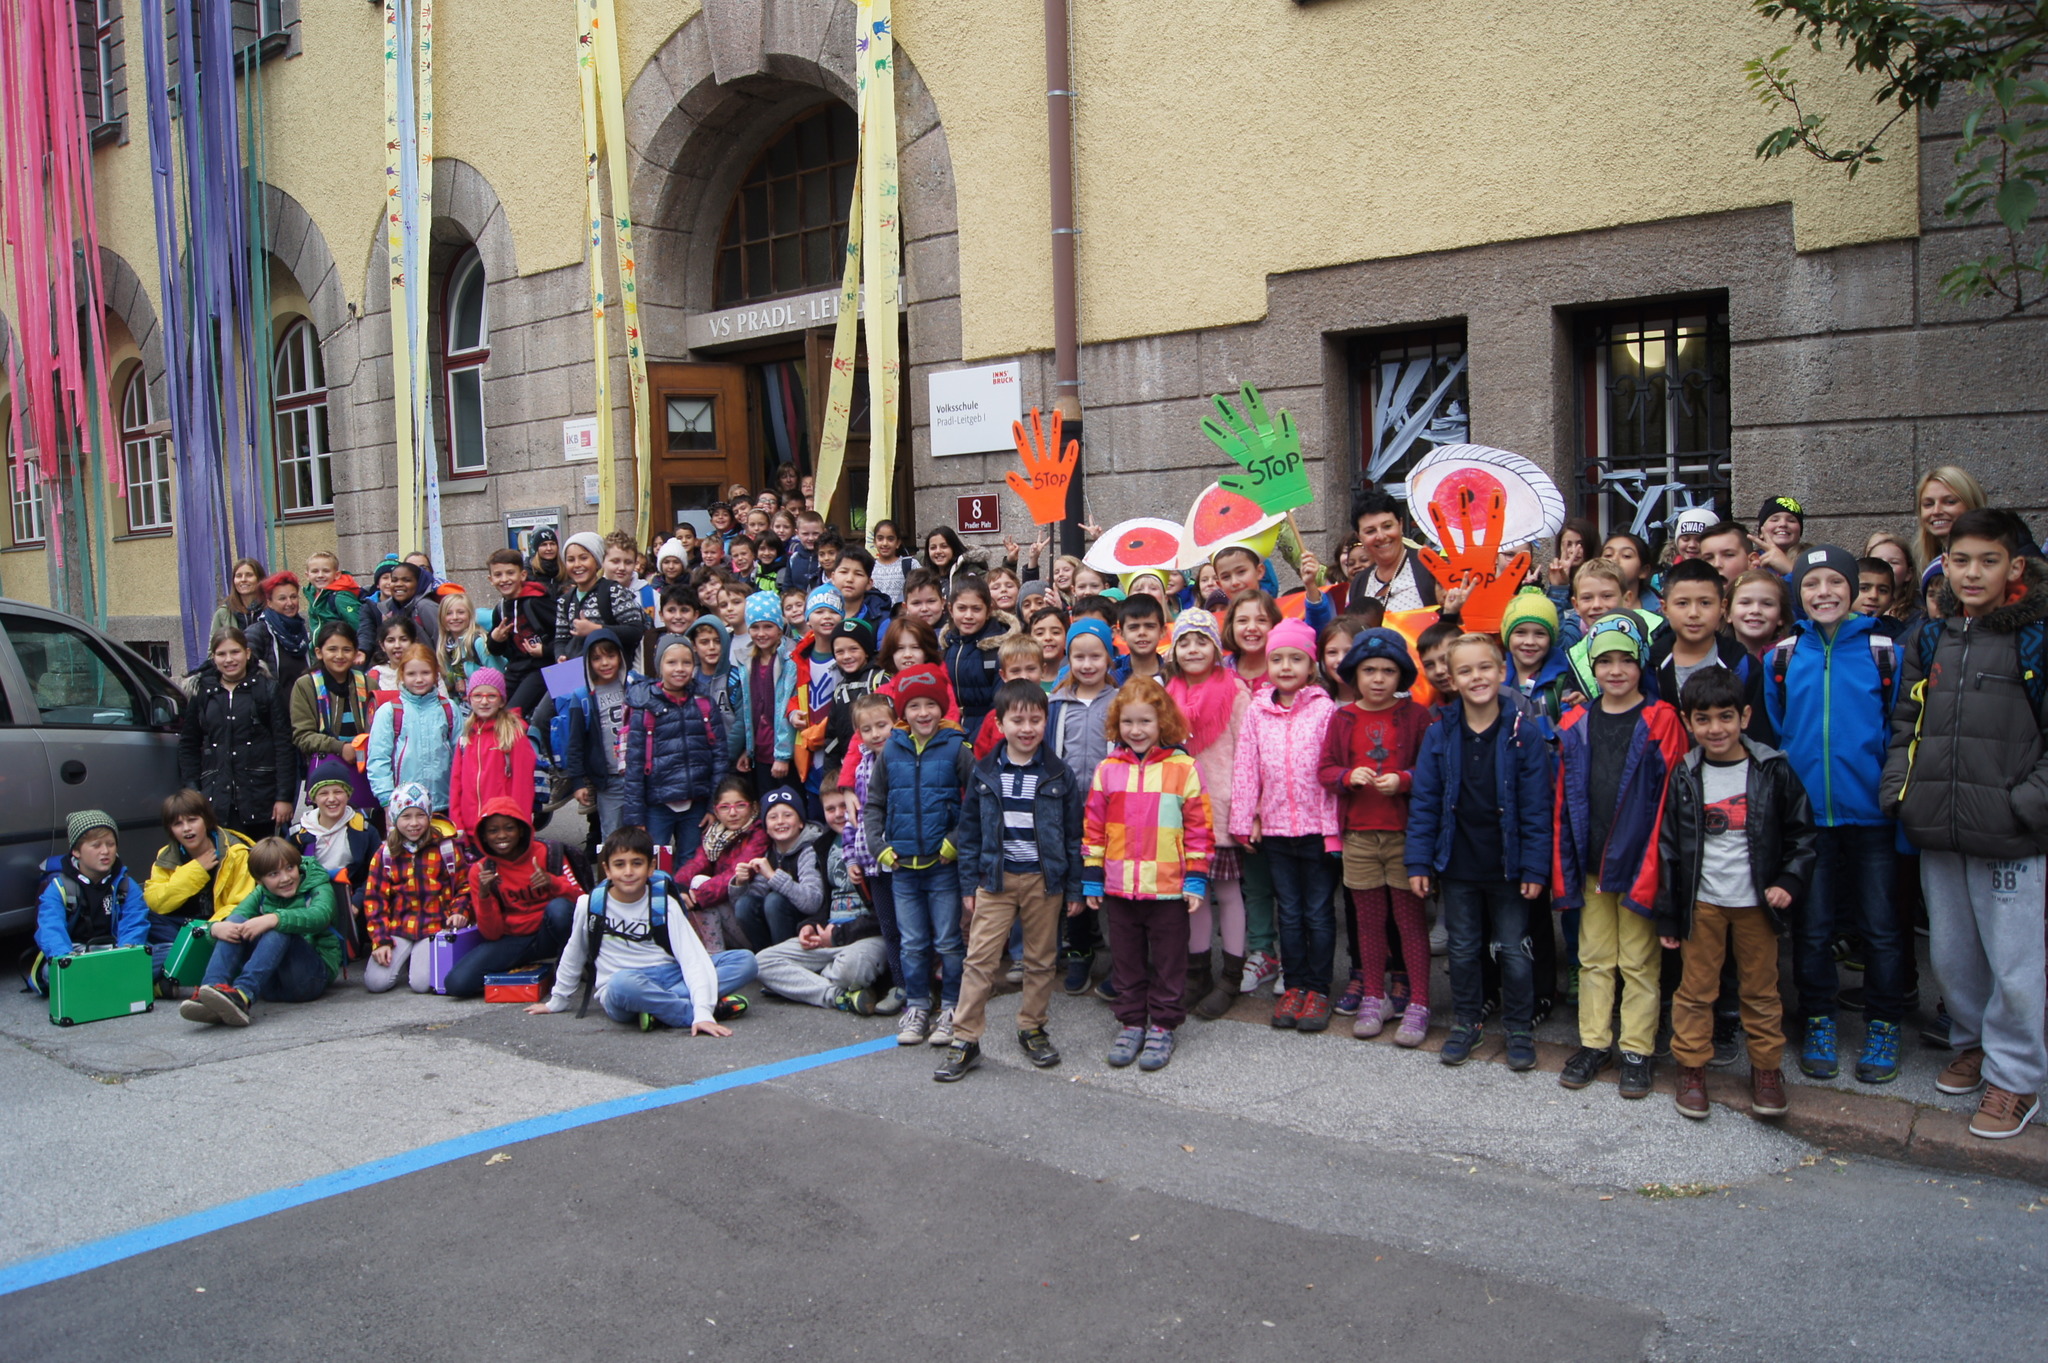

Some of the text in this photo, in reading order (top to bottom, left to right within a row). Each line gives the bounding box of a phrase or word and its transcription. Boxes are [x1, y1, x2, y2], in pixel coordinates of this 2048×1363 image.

[709, 316, 731, 338] VS
[992, 376, 1014, 385] BRUCK
[936, 401, 979, 413] Volksschule
[937, 414, 982, 426] Pradl-Leitgeb
[1247, 452, 1300, 486] STOP
[1034, 472, 1068, 490] STOP
[972, 499, 982, 519] 8
[1682, 522, 1704, 533] SWAG
[1448, 567, 1496, 589] STOP
[1992, 869, 2017, 891] 68
